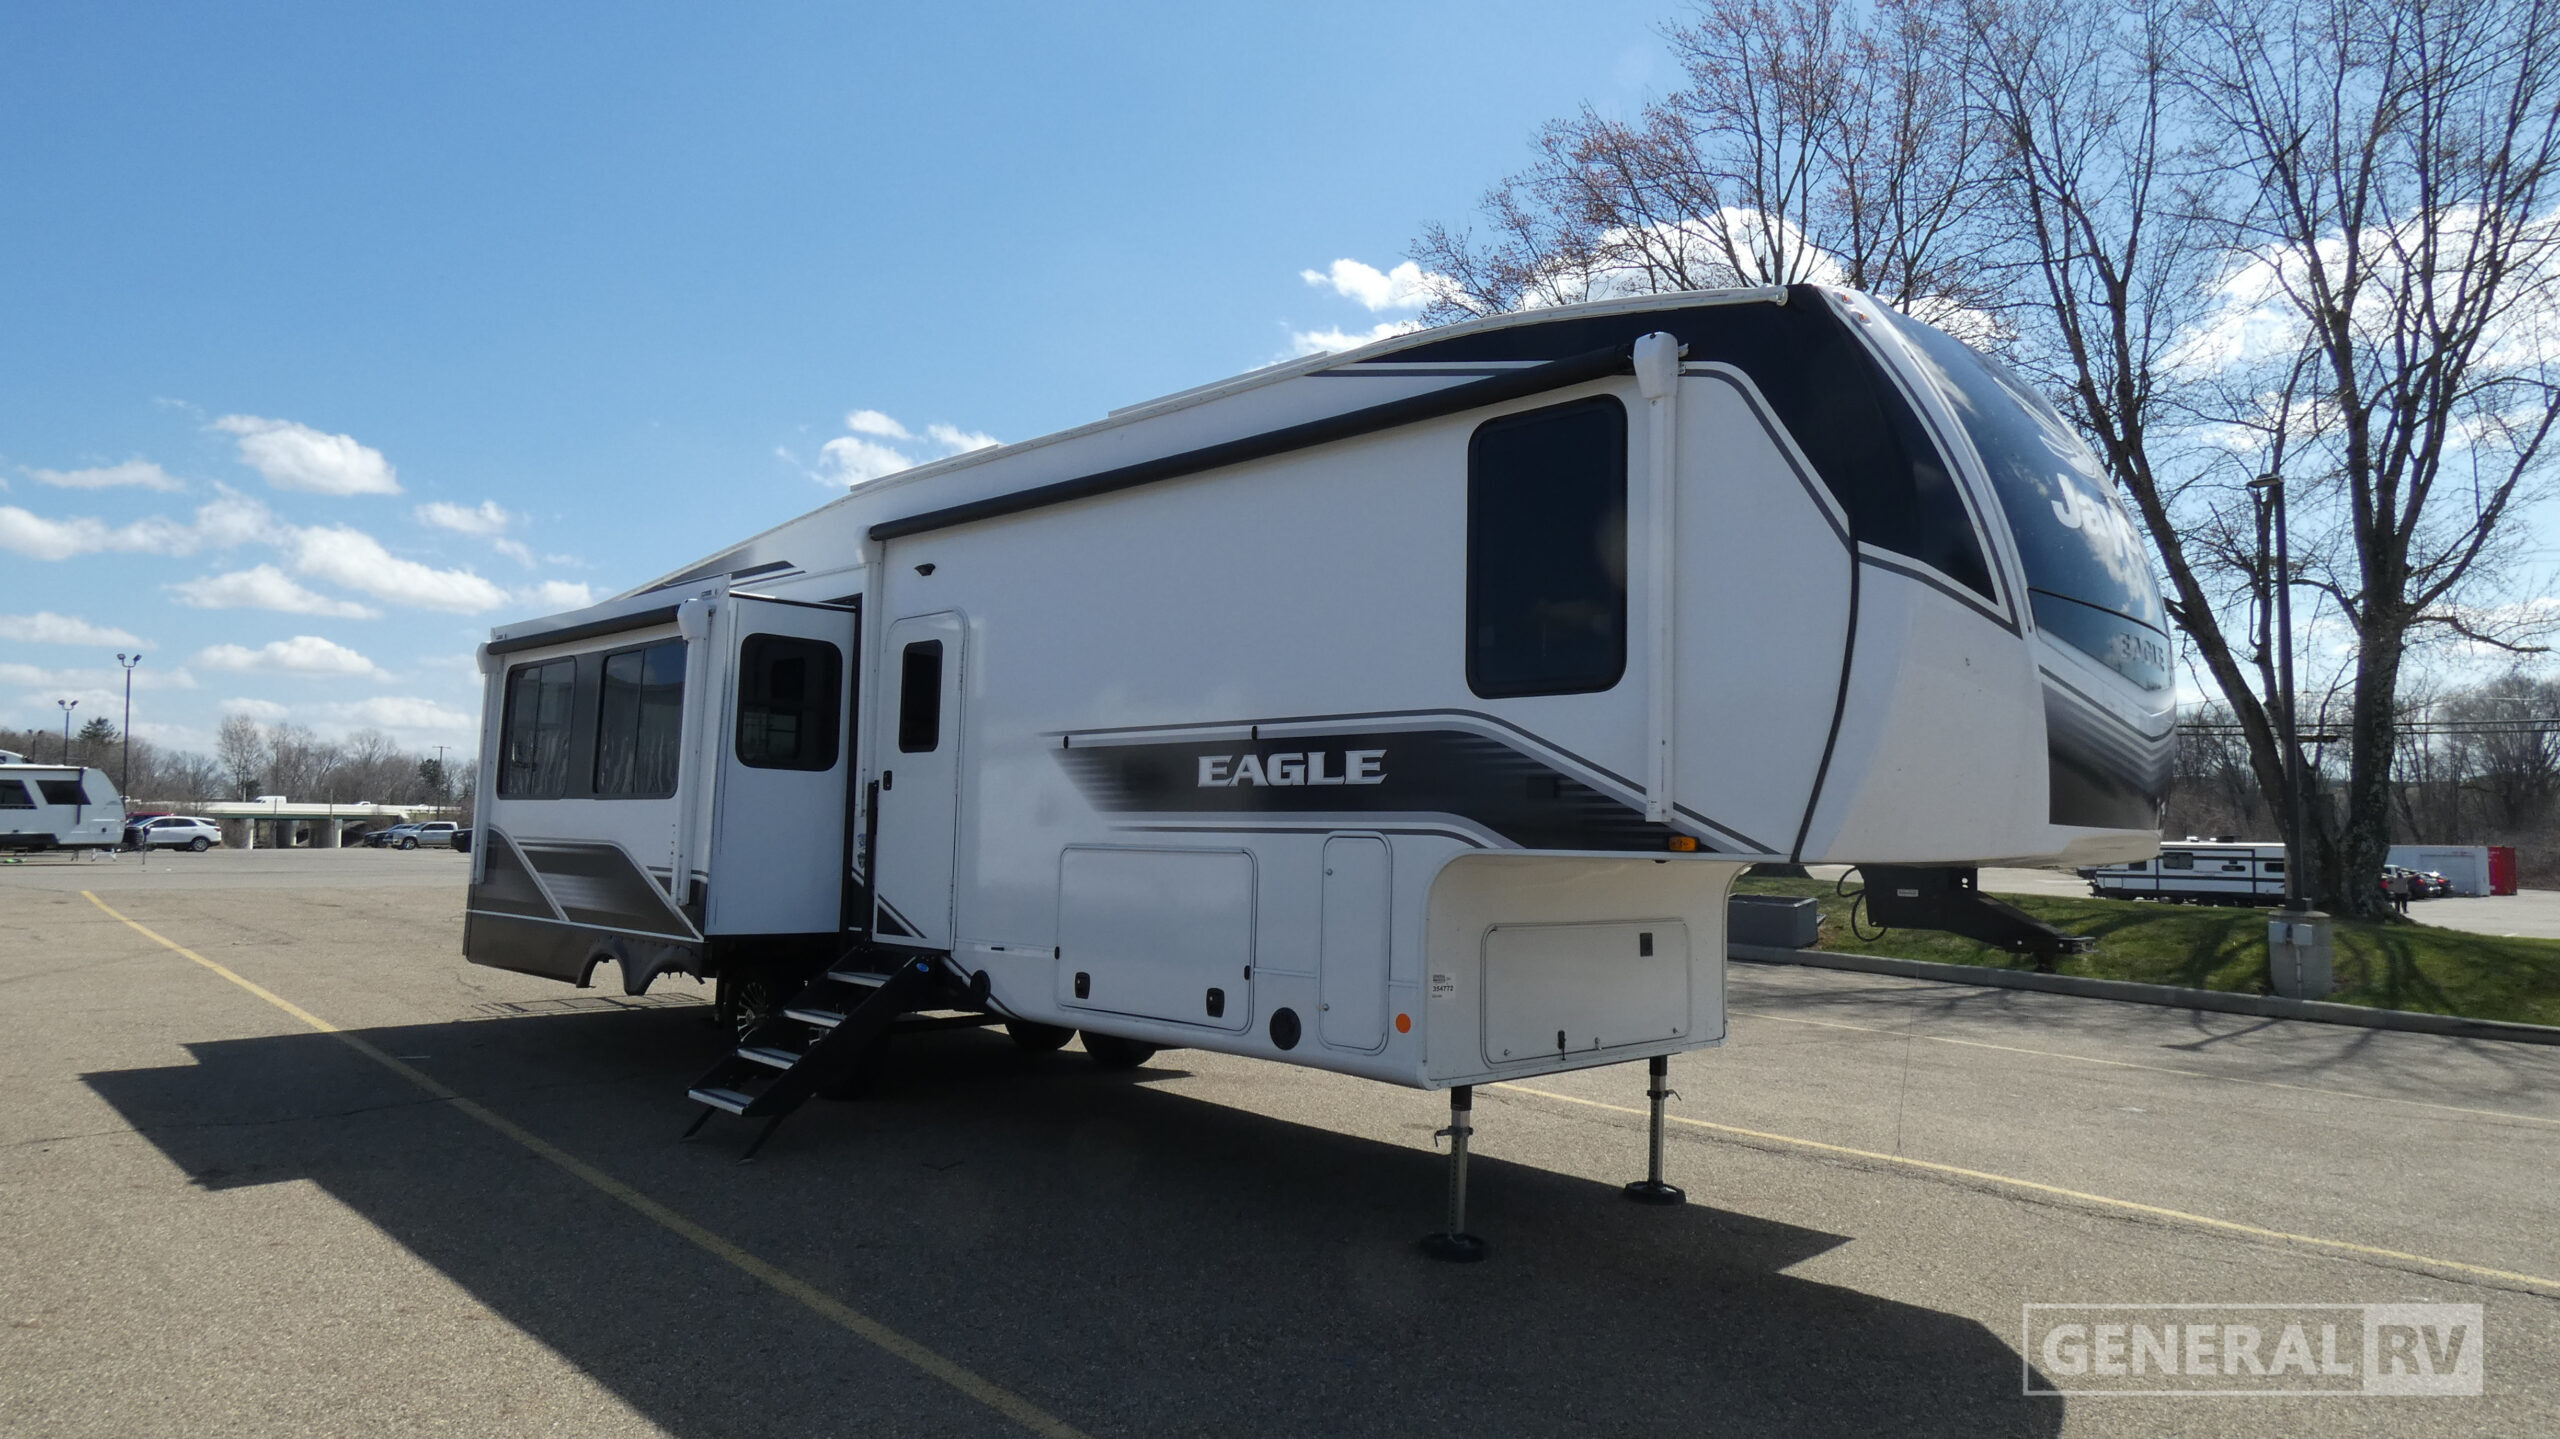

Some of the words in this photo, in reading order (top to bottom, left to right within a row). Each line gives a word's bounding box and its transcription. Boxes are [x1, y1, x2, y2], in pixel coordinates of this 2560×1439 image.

[2050, 472, 2142, 562] Jay
[2119, 631, 2166, 672] EAGLE
[1197, 749, 1389, 788] EAGLE
